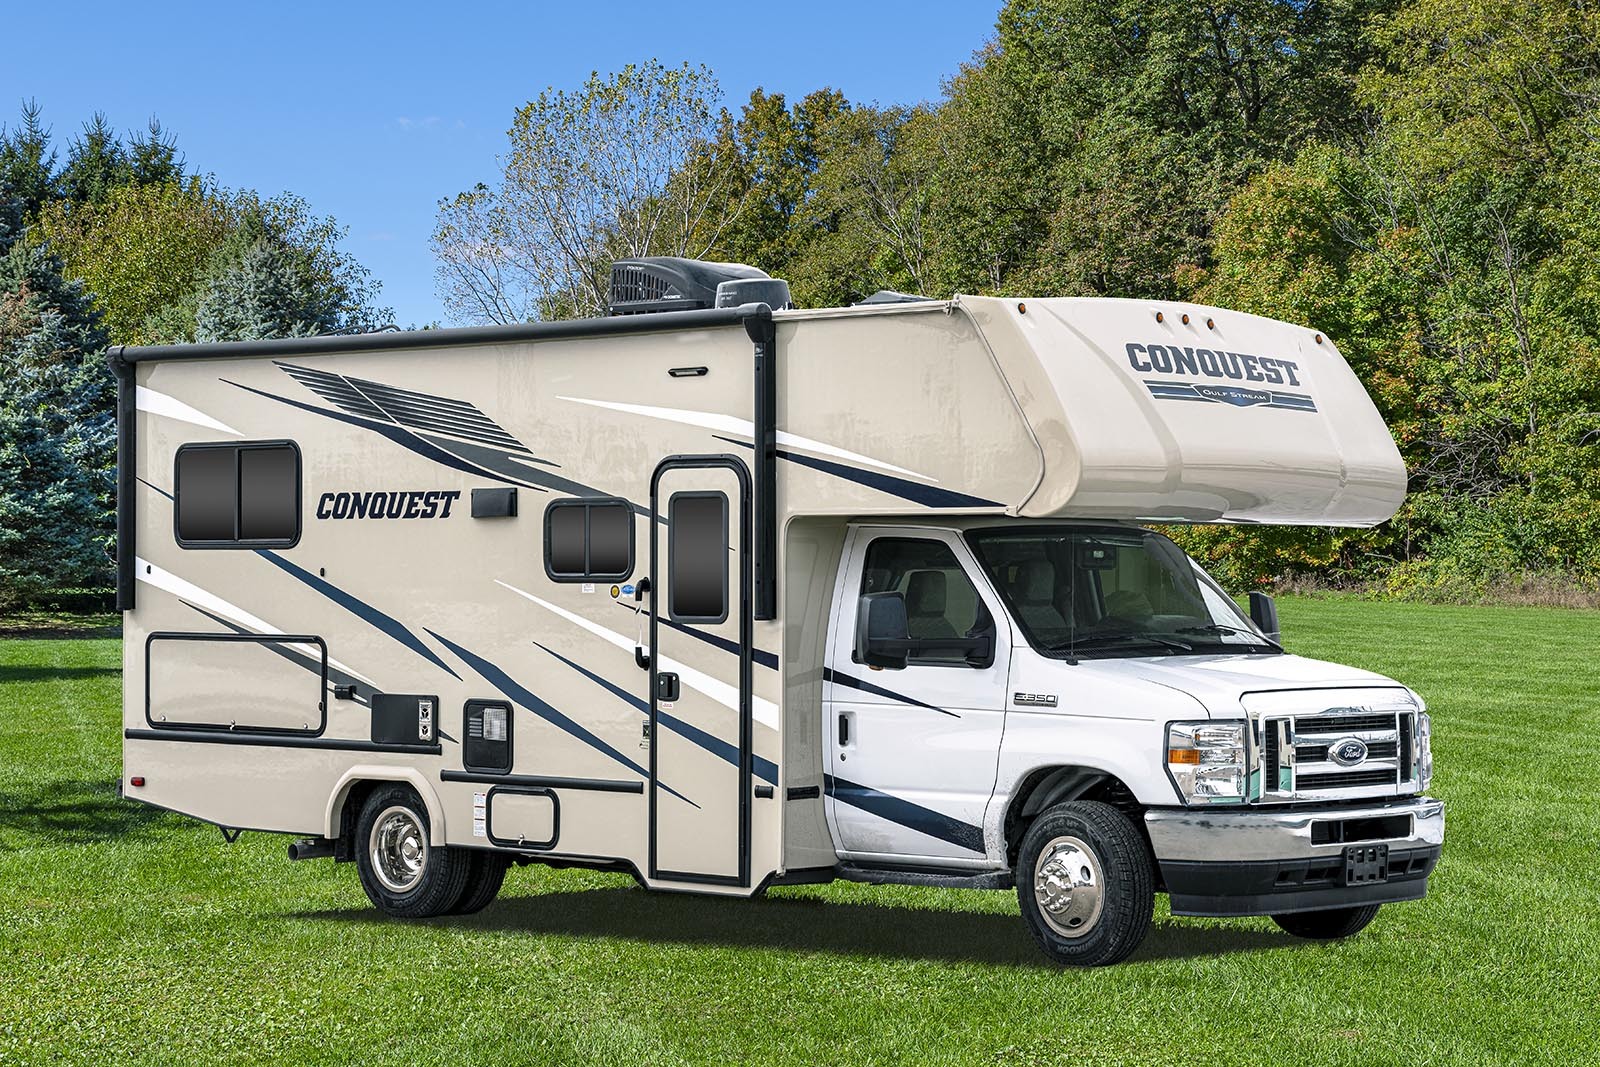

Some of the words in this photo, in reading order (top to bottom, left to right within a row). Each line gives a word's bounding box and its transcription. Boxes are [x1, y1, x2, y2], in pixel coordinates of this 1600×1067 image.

[1125, 342, 1300, 387] CONQUEST
[1202, 389, 1228, 397] GULF
[1229, 391, 1267, 400] STREAM
[316, 490, 461, 520] CONQUEST
[1344, 745, 1362, 758] Ford
